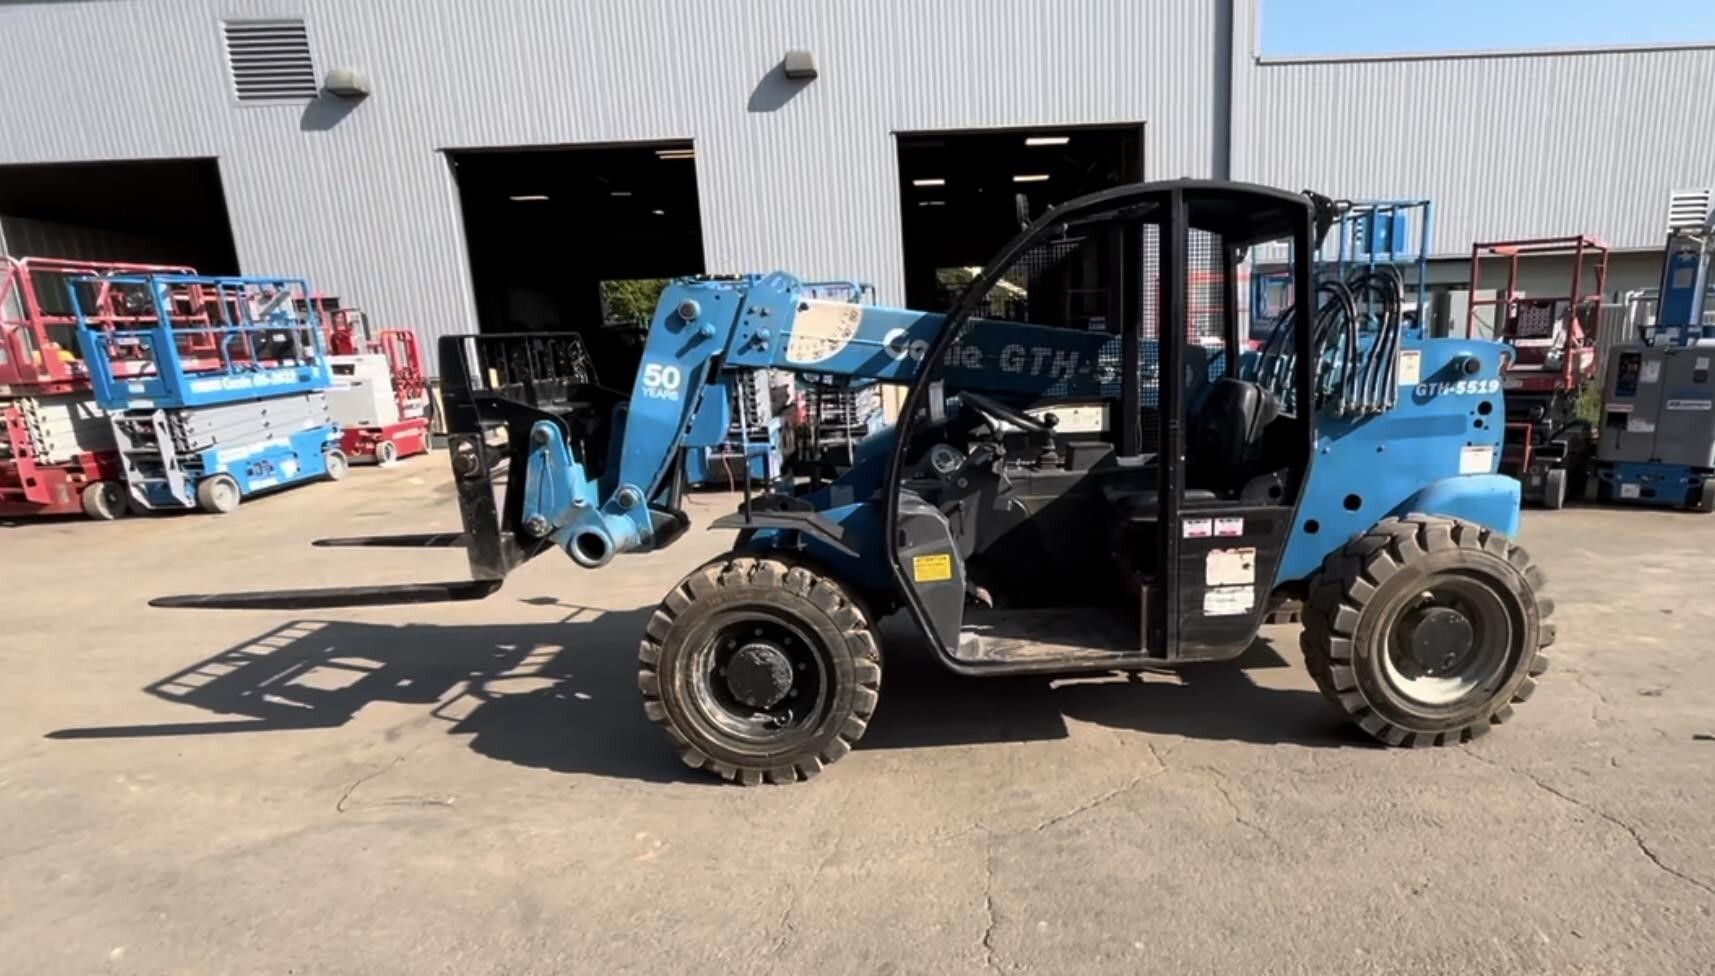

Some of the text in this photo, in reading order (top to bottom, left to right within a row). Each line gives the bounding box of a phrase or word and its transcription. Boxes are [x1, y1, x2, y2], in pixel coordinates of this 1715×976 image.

[643, 363, 681, 390] 50
[641, 386, 680, 402] YEARS
[1415, 380, 1500, 397] GTH-5519
